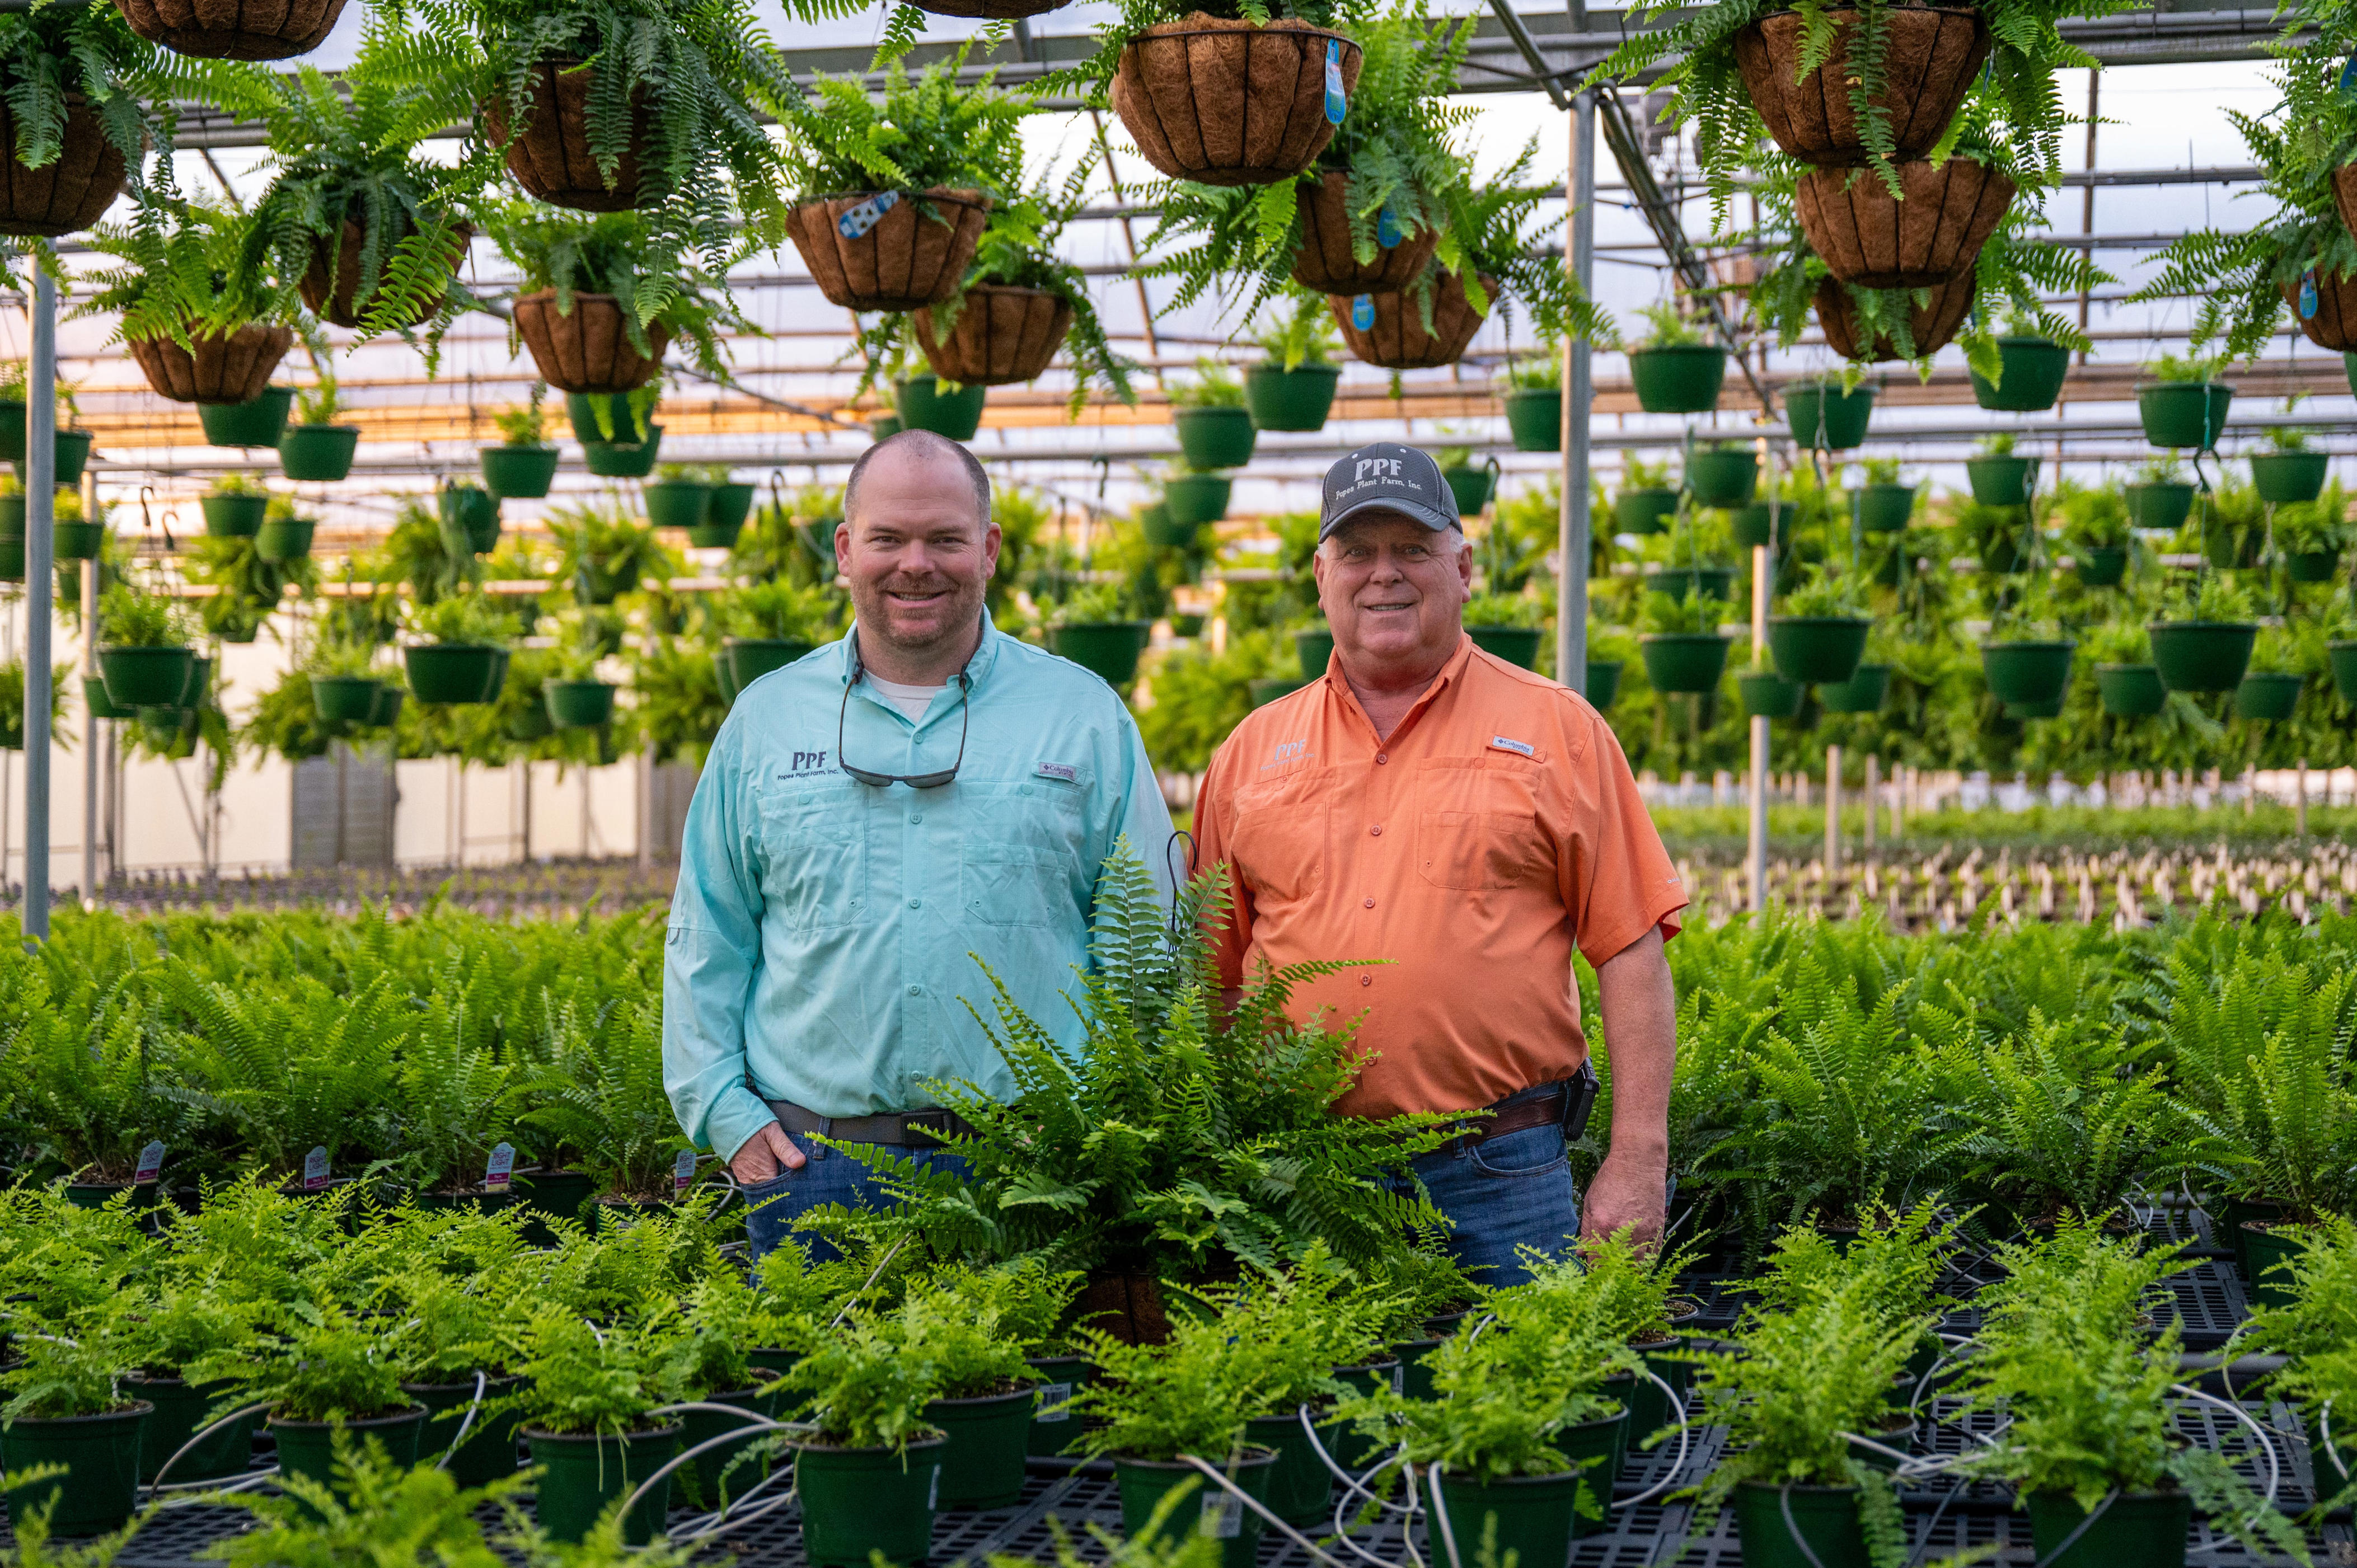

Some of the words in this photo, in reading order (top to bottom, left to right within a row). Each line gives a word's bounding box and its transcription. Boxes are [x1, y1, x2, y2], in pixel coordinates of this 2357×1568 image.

[1354, 458, 1402, 482] PPF
[1336, 485, 1355, 500] Popes
[1356, 478, 1377, 490] Plant
[1381, 476, 1405, 486] Farm,
[1408, 480, 1422, 490] Inc.
[1274, 738, 1306, 760] PPF
[1504, 740, 1530, 751] Columbia
[791, 751, 827, 771] PPF
[1050, 764, 1074, 775] Columbia
[678, 1161, 692, 1170] LIGHT
